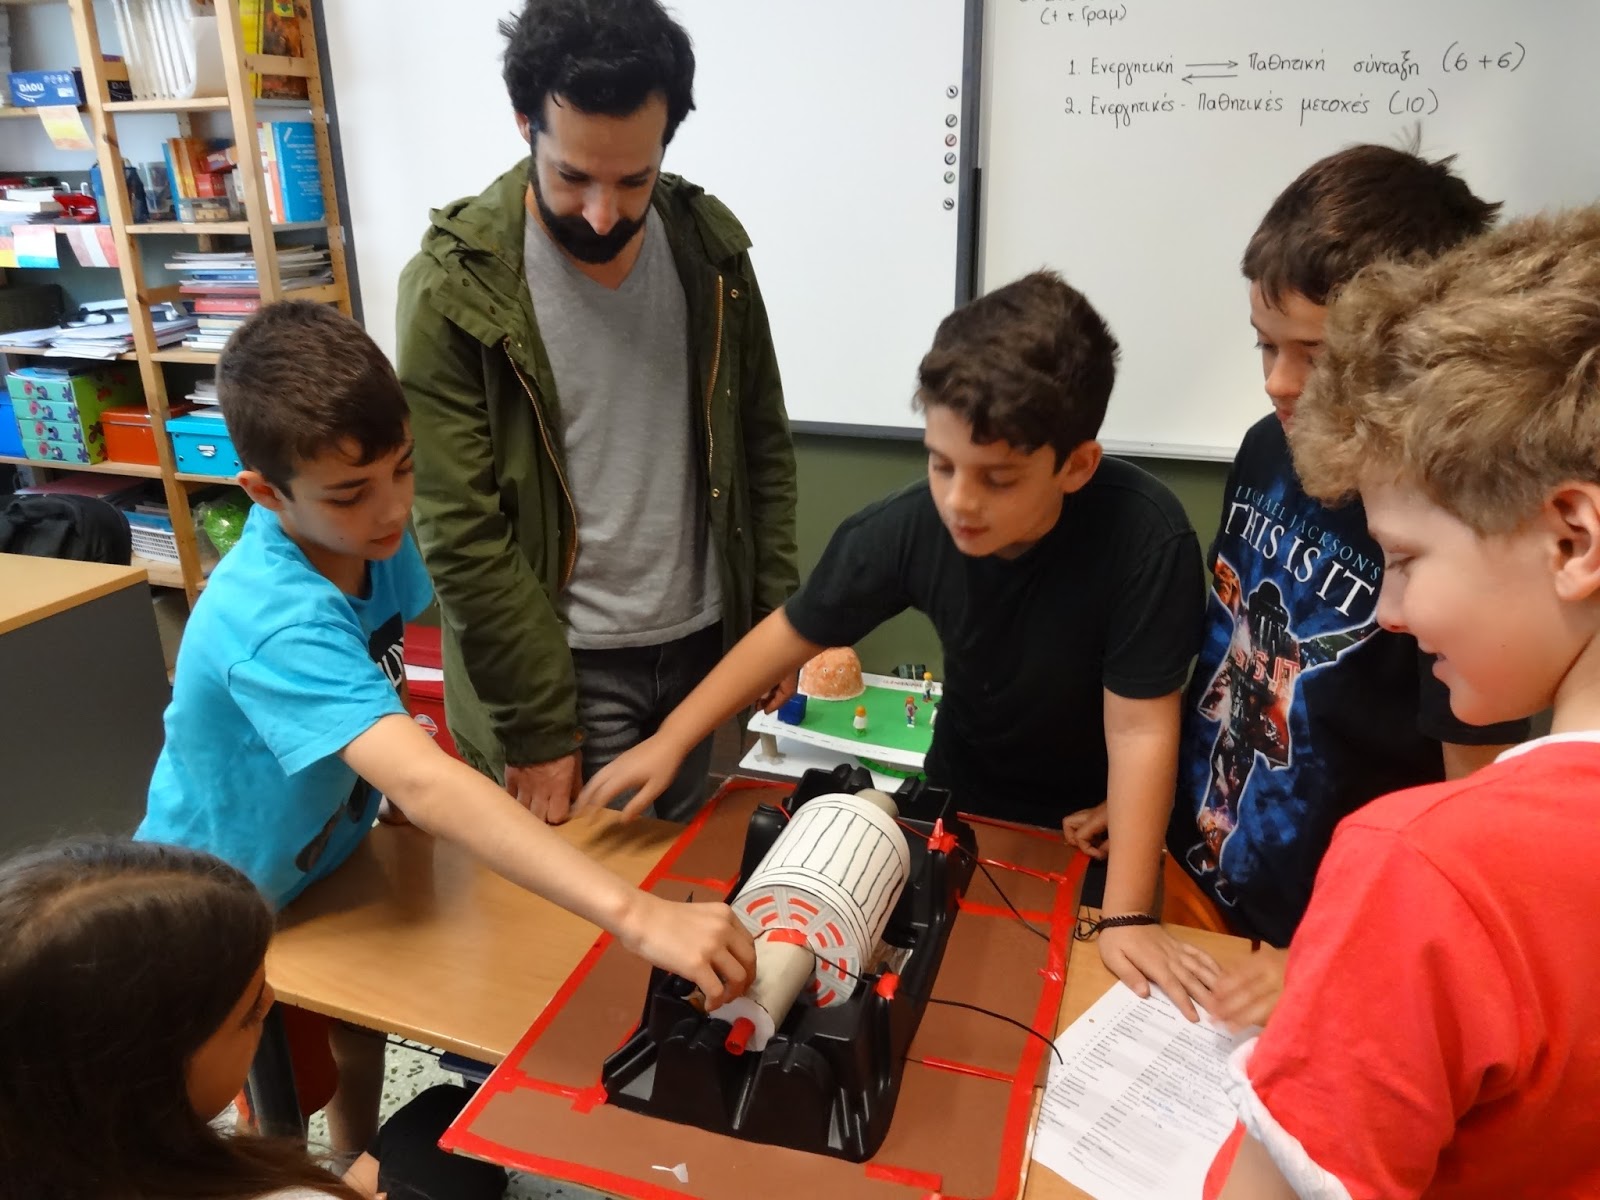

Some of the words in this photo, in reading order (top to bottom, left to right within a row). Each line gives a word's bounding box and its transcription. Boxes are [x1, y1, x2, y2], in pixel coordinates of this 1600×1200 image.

[1068, 59, 1081, 76] 1.
[1091, 55, 1174, 88] Ενεργητική
[1249, 49, 1326, 72] Παθητική
[1353, 50, 1420, 81] σύνταξη
[1064, 97, 1082, 115] 2.
[1300, 93, 1370, 127] μετοχές
[1388, 88, 1439, 115] (10)
[1289, 512, 1381, 581] JACKSON'S
[1282, 536, 1321, 583] IS
[1316, 560, 1376, 618] IT
